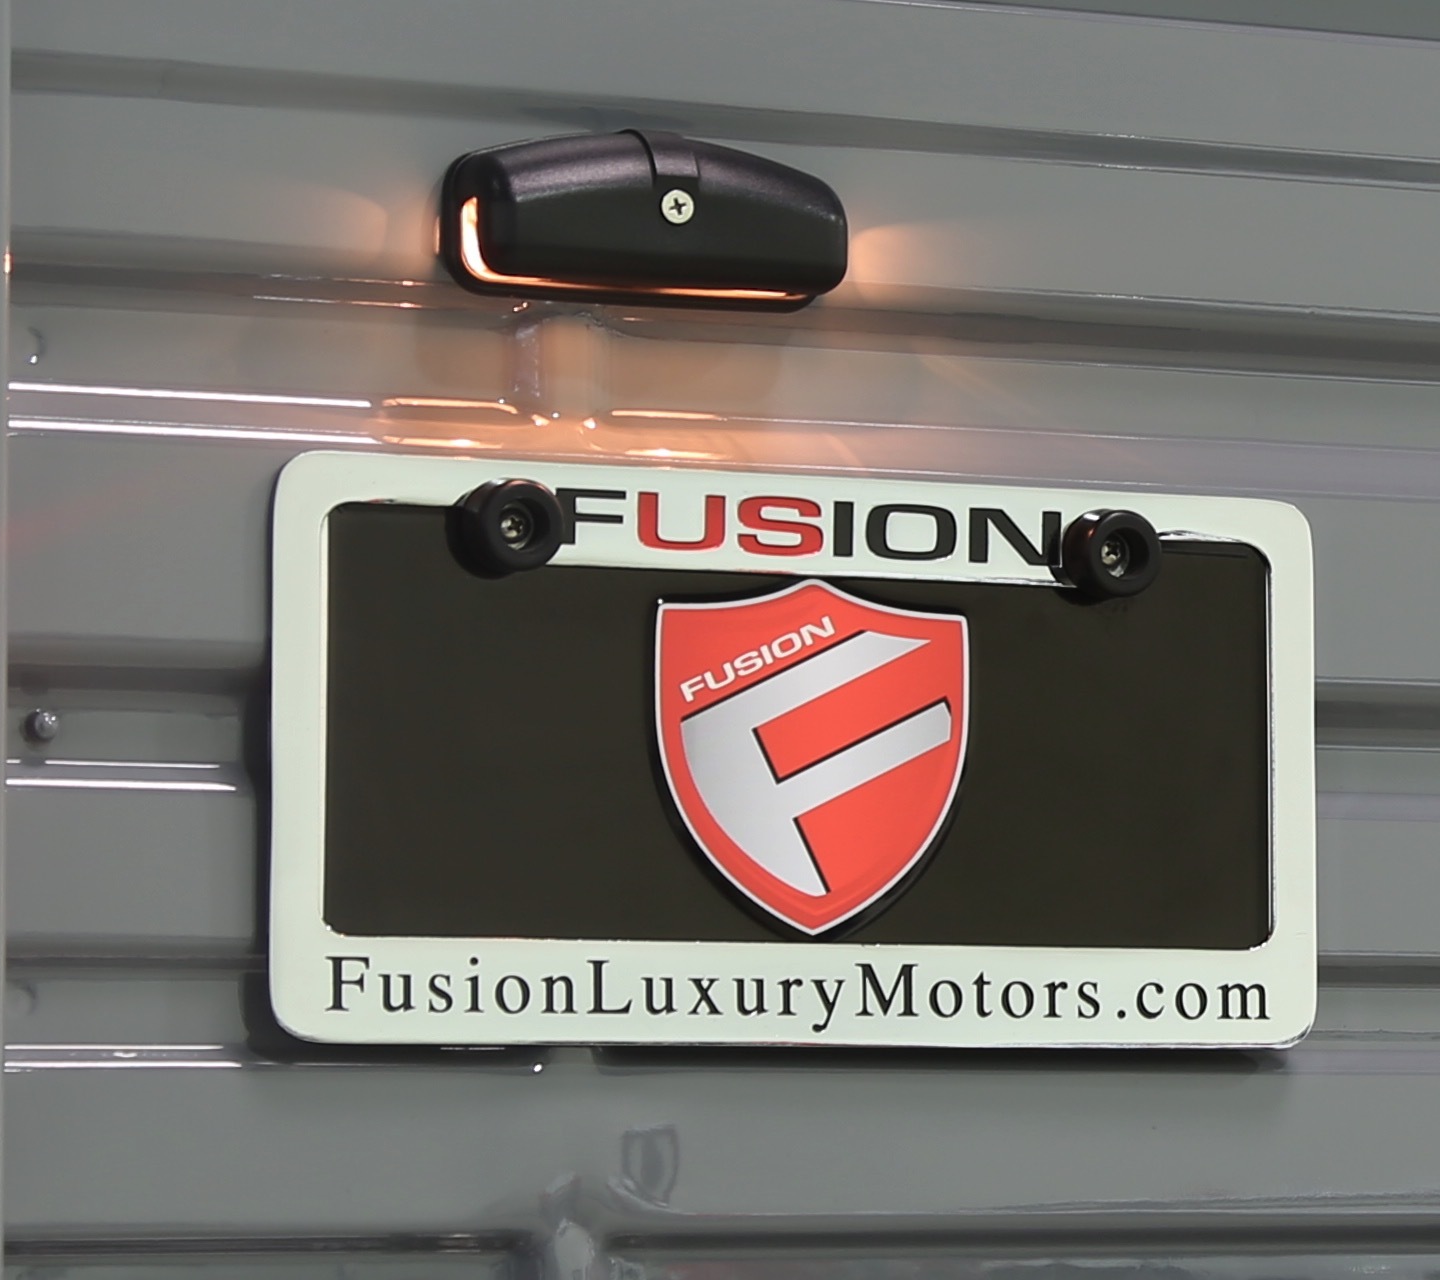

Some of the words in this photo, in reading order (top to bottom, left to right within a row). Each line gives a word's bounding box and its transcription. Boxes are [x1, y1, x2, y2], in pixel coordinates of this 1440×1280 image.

[556, 487, 1062, 567] FUSION
[679, 615, 836, 703] FUSION
[324, 955, 1273, 1030] FusionLuxuryMotors.com
